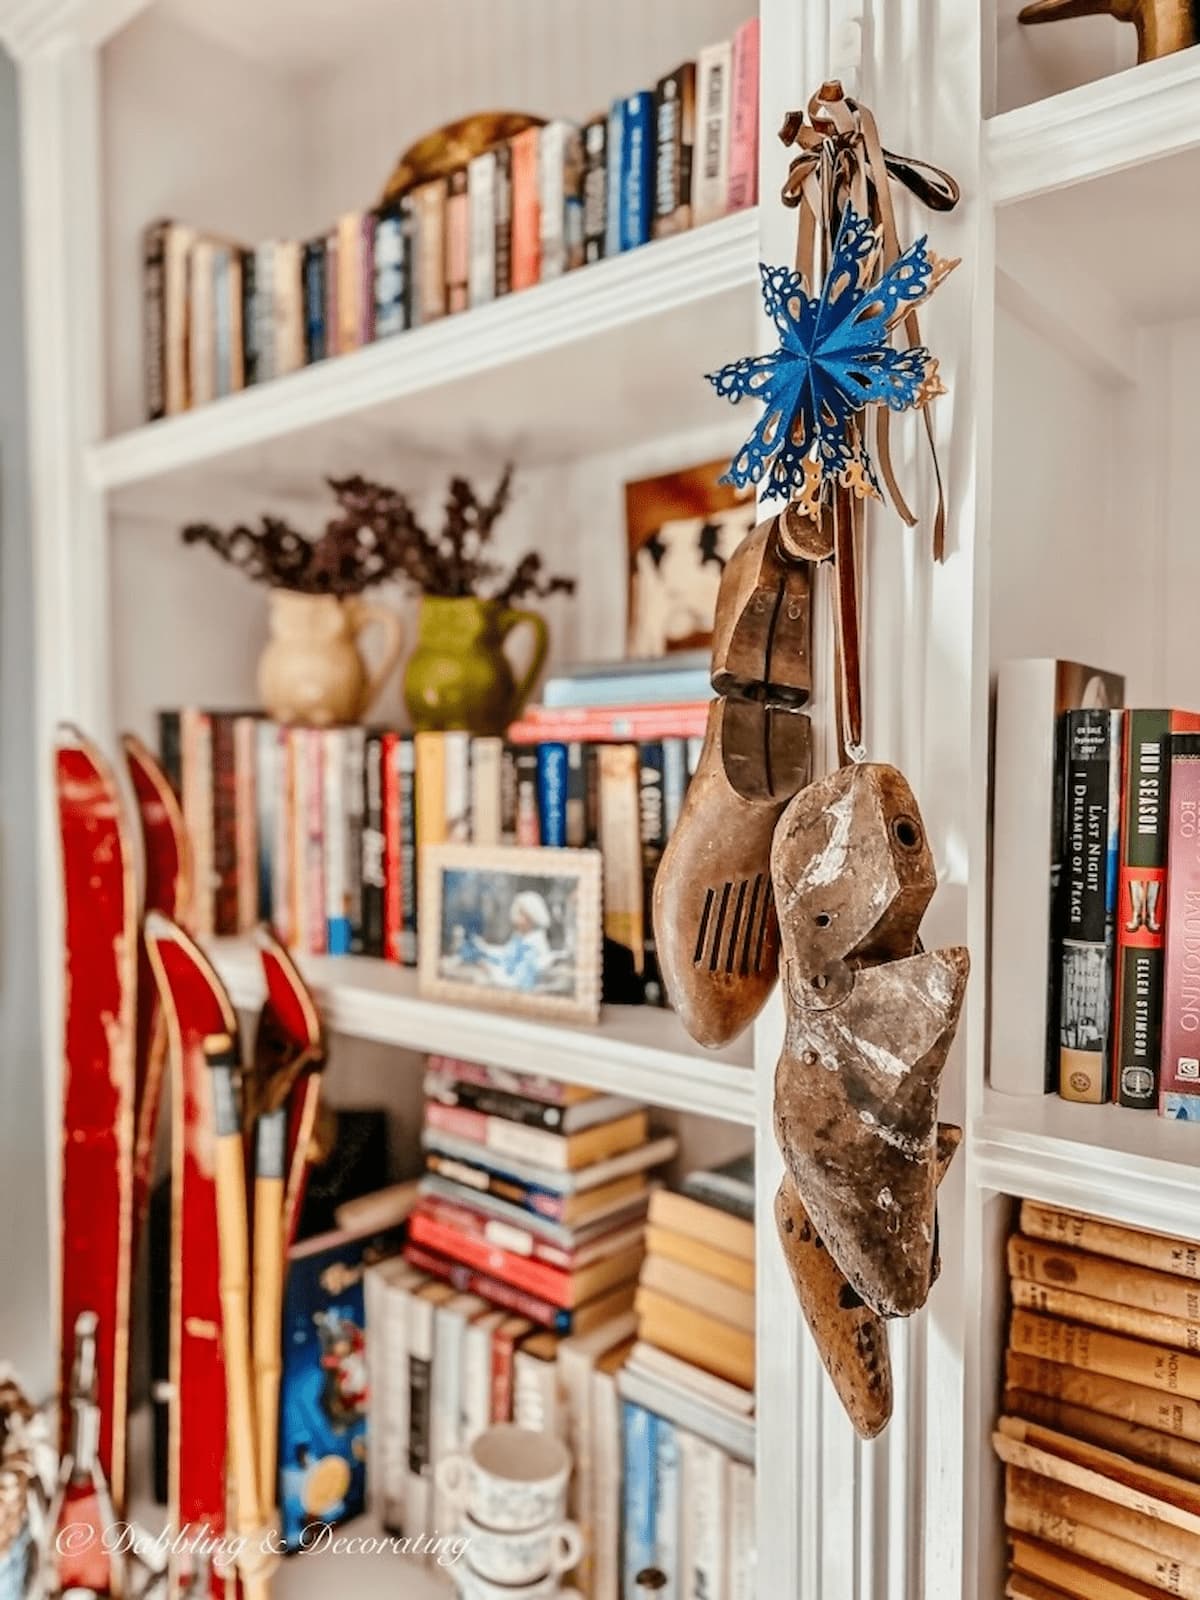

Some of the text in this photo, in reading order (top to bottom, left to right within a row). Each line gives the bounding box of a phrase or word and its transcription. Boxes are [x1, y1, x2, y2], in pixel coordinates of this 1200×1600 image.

[1072, 784, 1087, 851] DREAMED
[1138, 743, 1161, 835] MUD SEASON
[1180, 801, 1197, 838] ECO
[1087, 805, 1103, 892] LAST NIGHT
[1071, 881, 1084, 923] PEACE
[1181, 890, 1200, 1033] BAUDOLINO
[1134, 958, 1150, 1056] ELLEN STIMSON
[1168, 1352, 1179, 1389] DIXON
